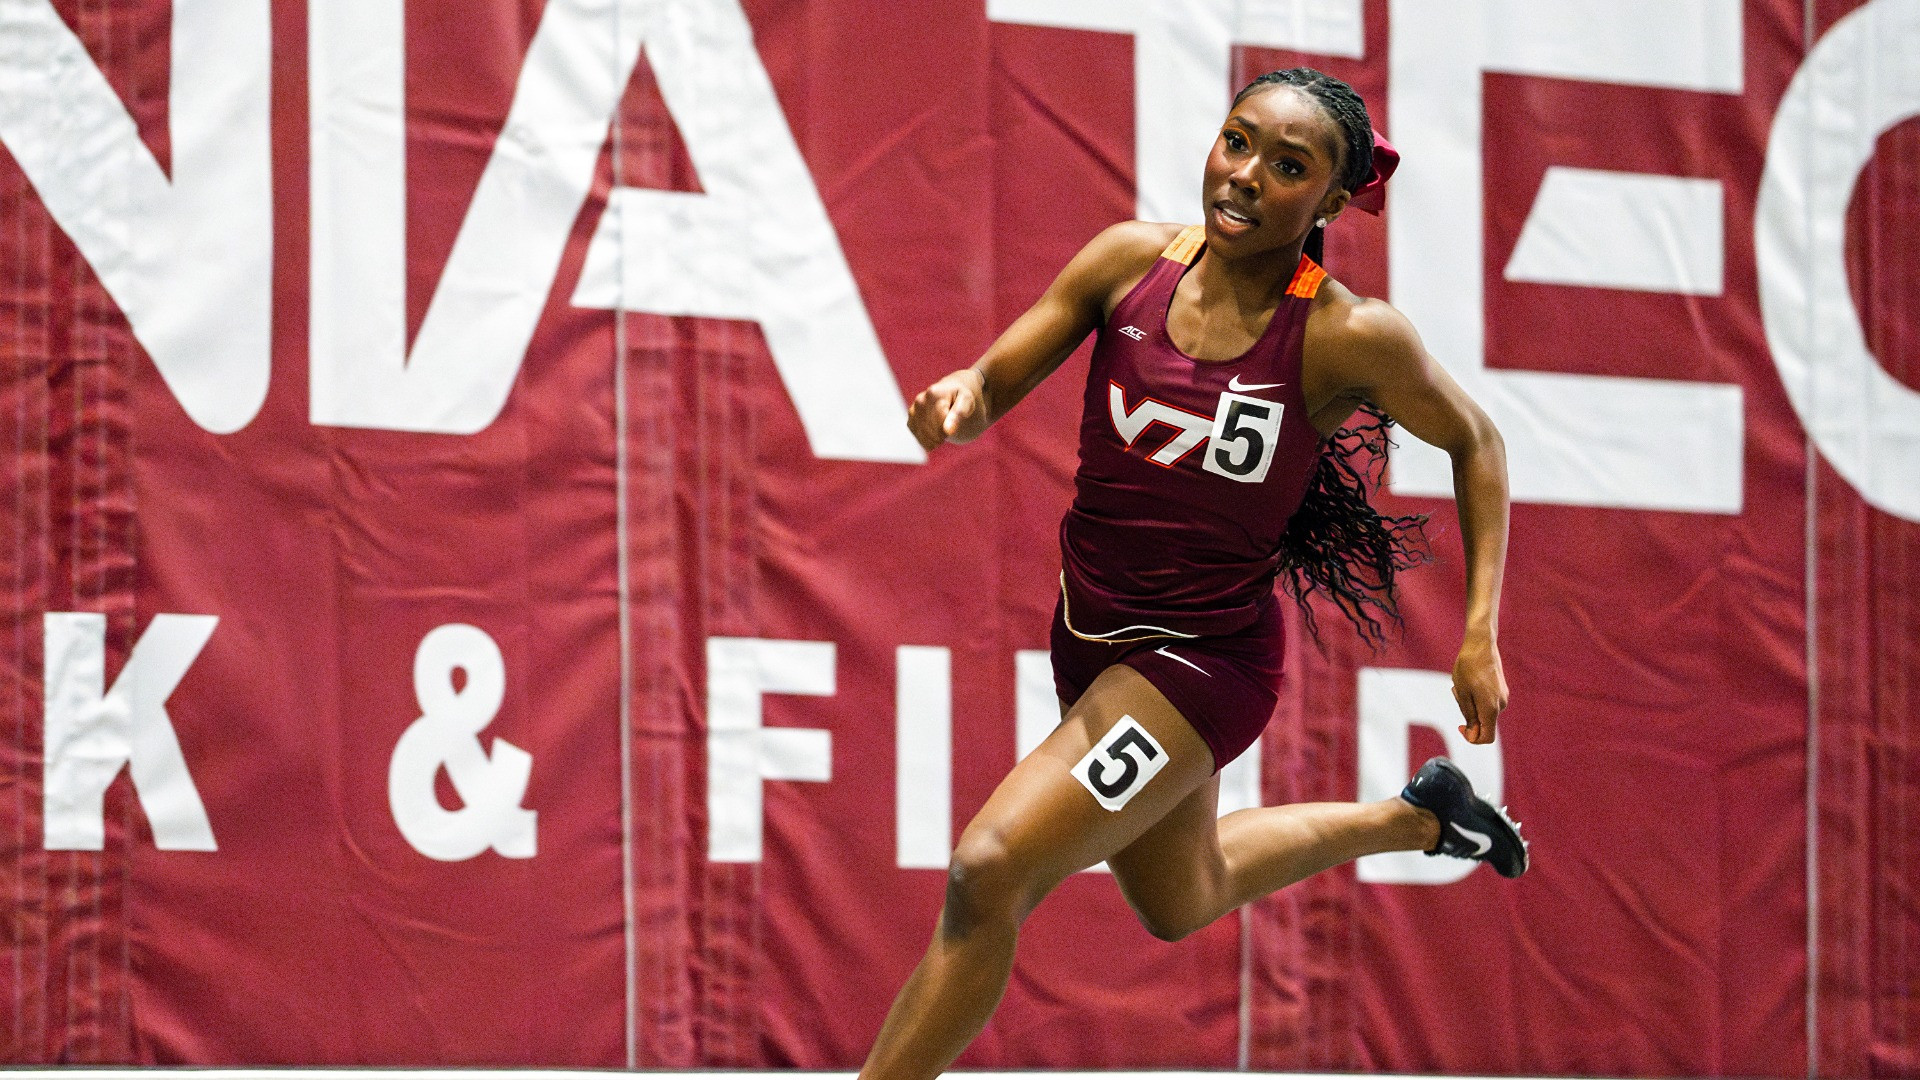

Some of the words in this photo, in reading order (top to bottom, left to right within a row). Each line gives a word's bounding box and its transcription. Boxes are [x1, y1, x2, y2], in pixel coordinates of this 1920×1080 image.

[1118, 325, 1148, 341] ACC
[1214, 399, 1271, 476] 5
[388, 622, 538, 861] &
[706, 636, 1505, 884] FID
[1087, 726, 1159, 799] 5
